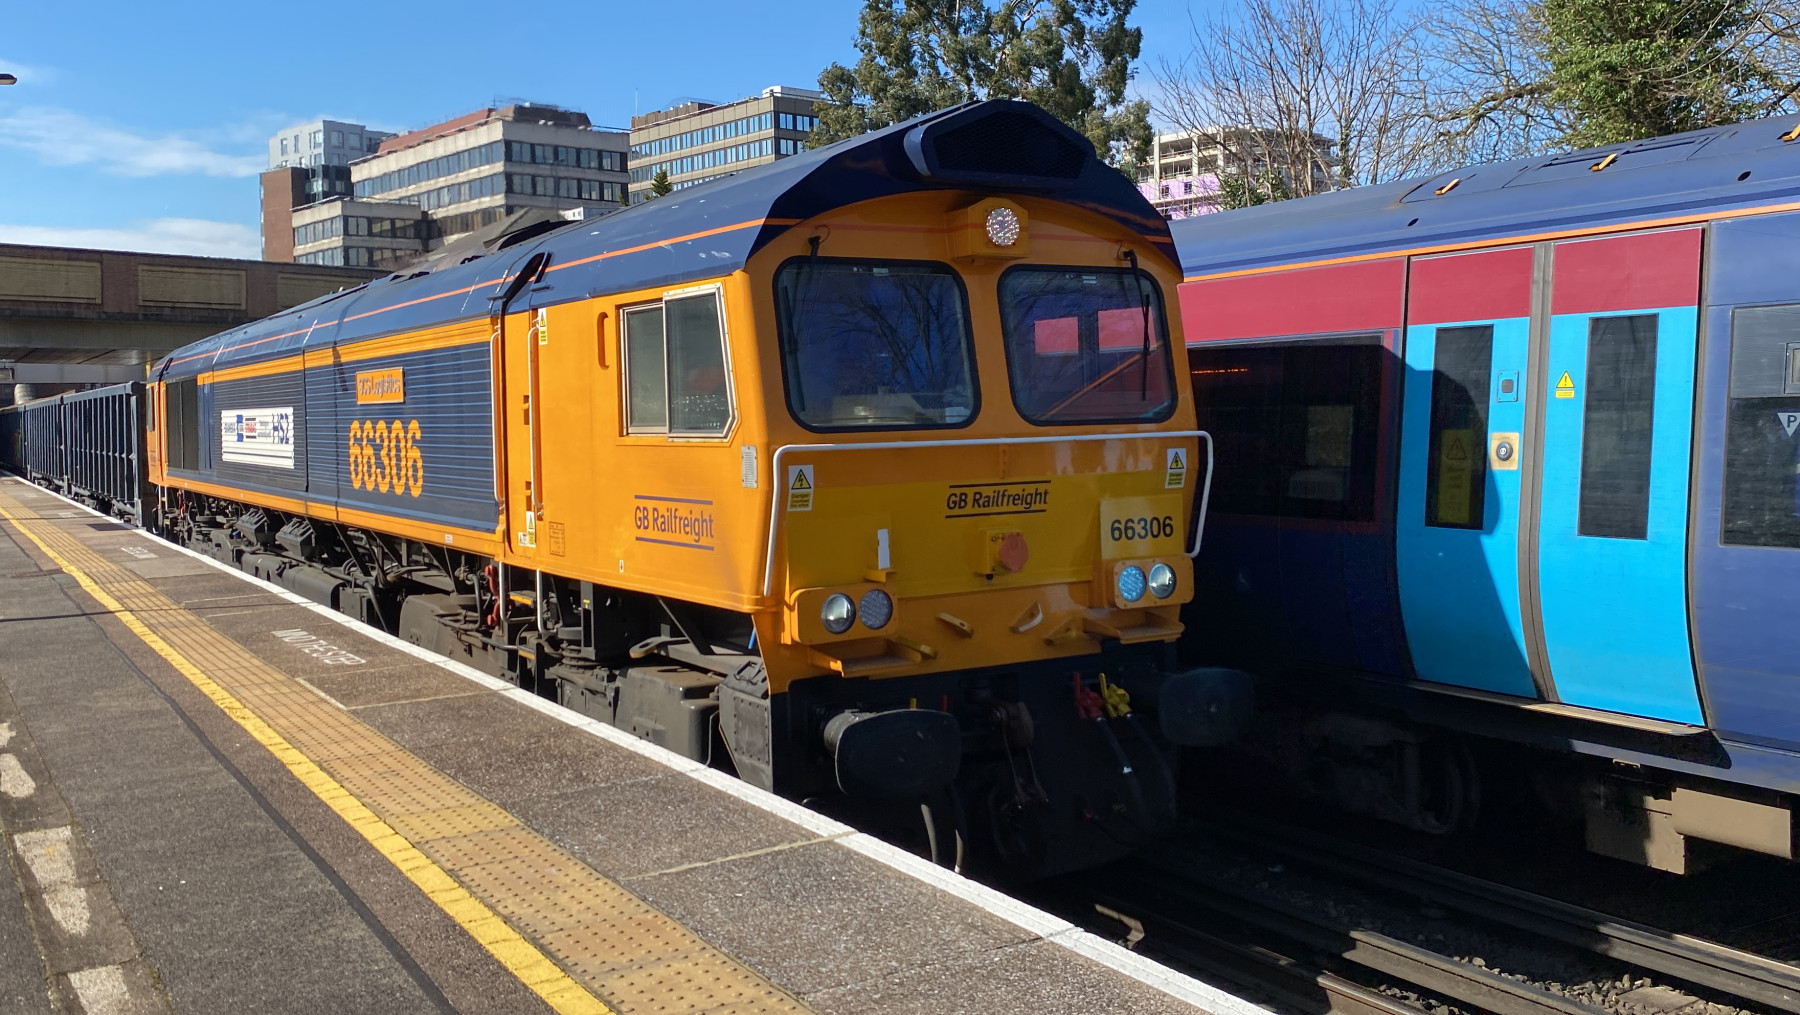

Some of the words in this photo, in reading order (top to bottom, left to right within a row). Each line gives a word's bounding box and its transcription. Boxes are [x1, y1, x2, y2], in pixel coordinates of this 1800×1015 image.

[271, 412, 290, 445] HS2
[1786, 414, 1798, 429] P
[348, 419, 424, 498] 66306
[946, 491, 969, 510] GB
[971, 487, 1050, 510] Railfreight
[634, 505, 650, 530] GB
[651, 506, 715, 543] Railfreight
[1110, 515, 1175, 542] 66306
